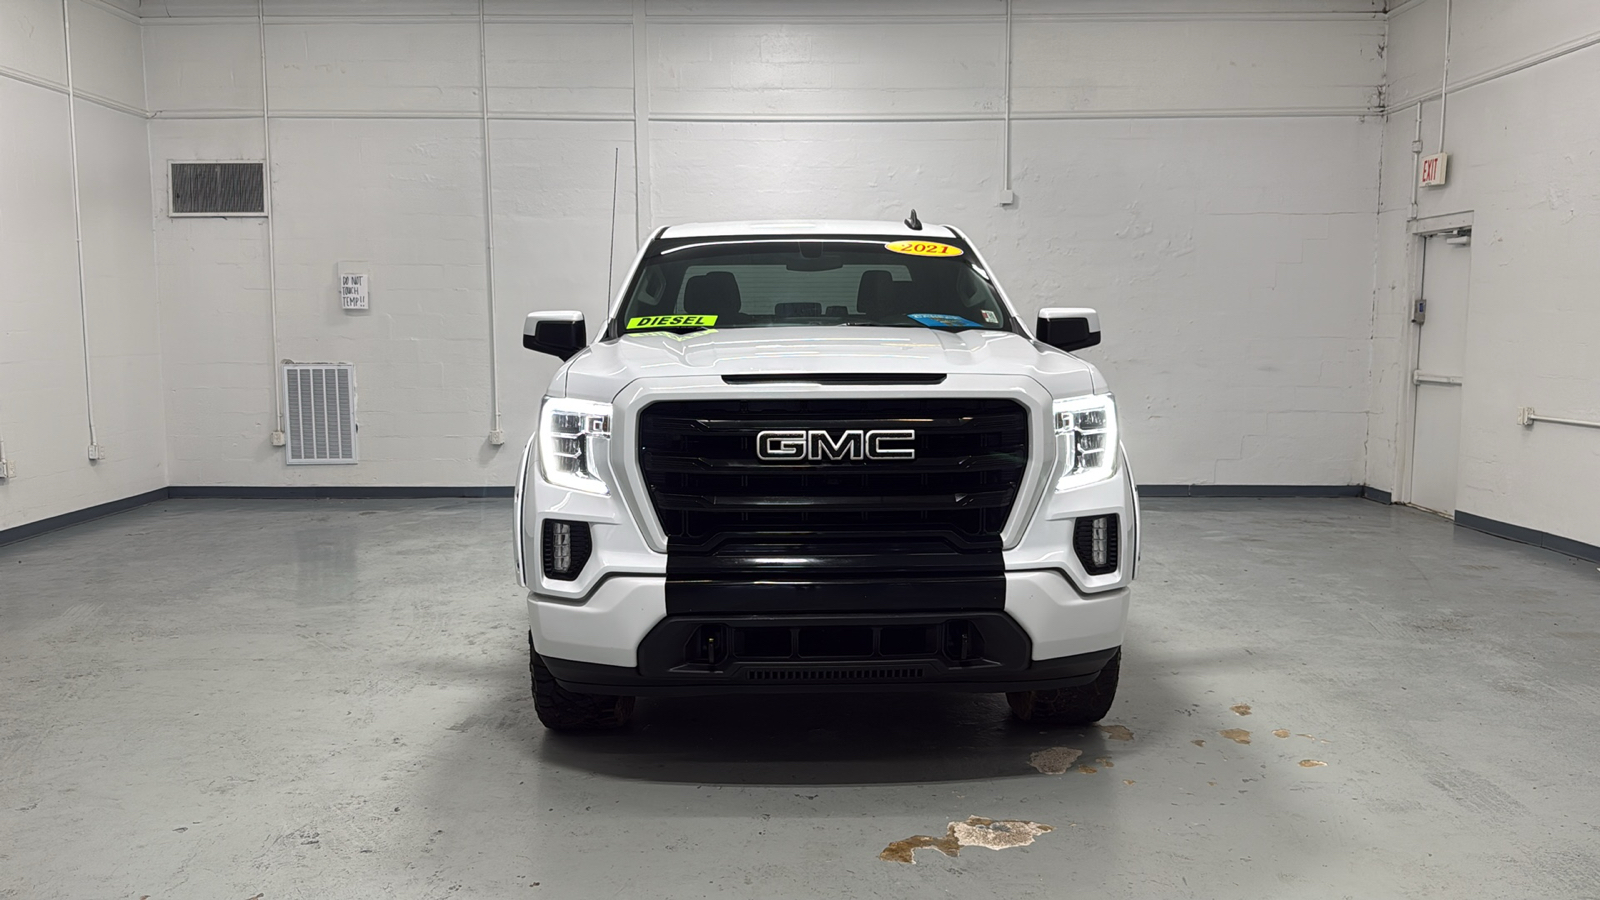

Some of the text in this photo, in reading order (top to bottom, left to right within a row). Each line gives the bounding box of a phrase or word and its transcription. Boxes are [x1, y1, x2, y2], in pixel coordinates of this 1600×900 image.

[1422, 158, 1438, 182] EXIT
[900, 243, 949, 254] 2021
[342, 275, 363, 286] DO NOT
[342, 286, 359, 295] TOUCH
[636, 316, 705, 326] DIESEL
[757, 430, 915, 460] GMC
